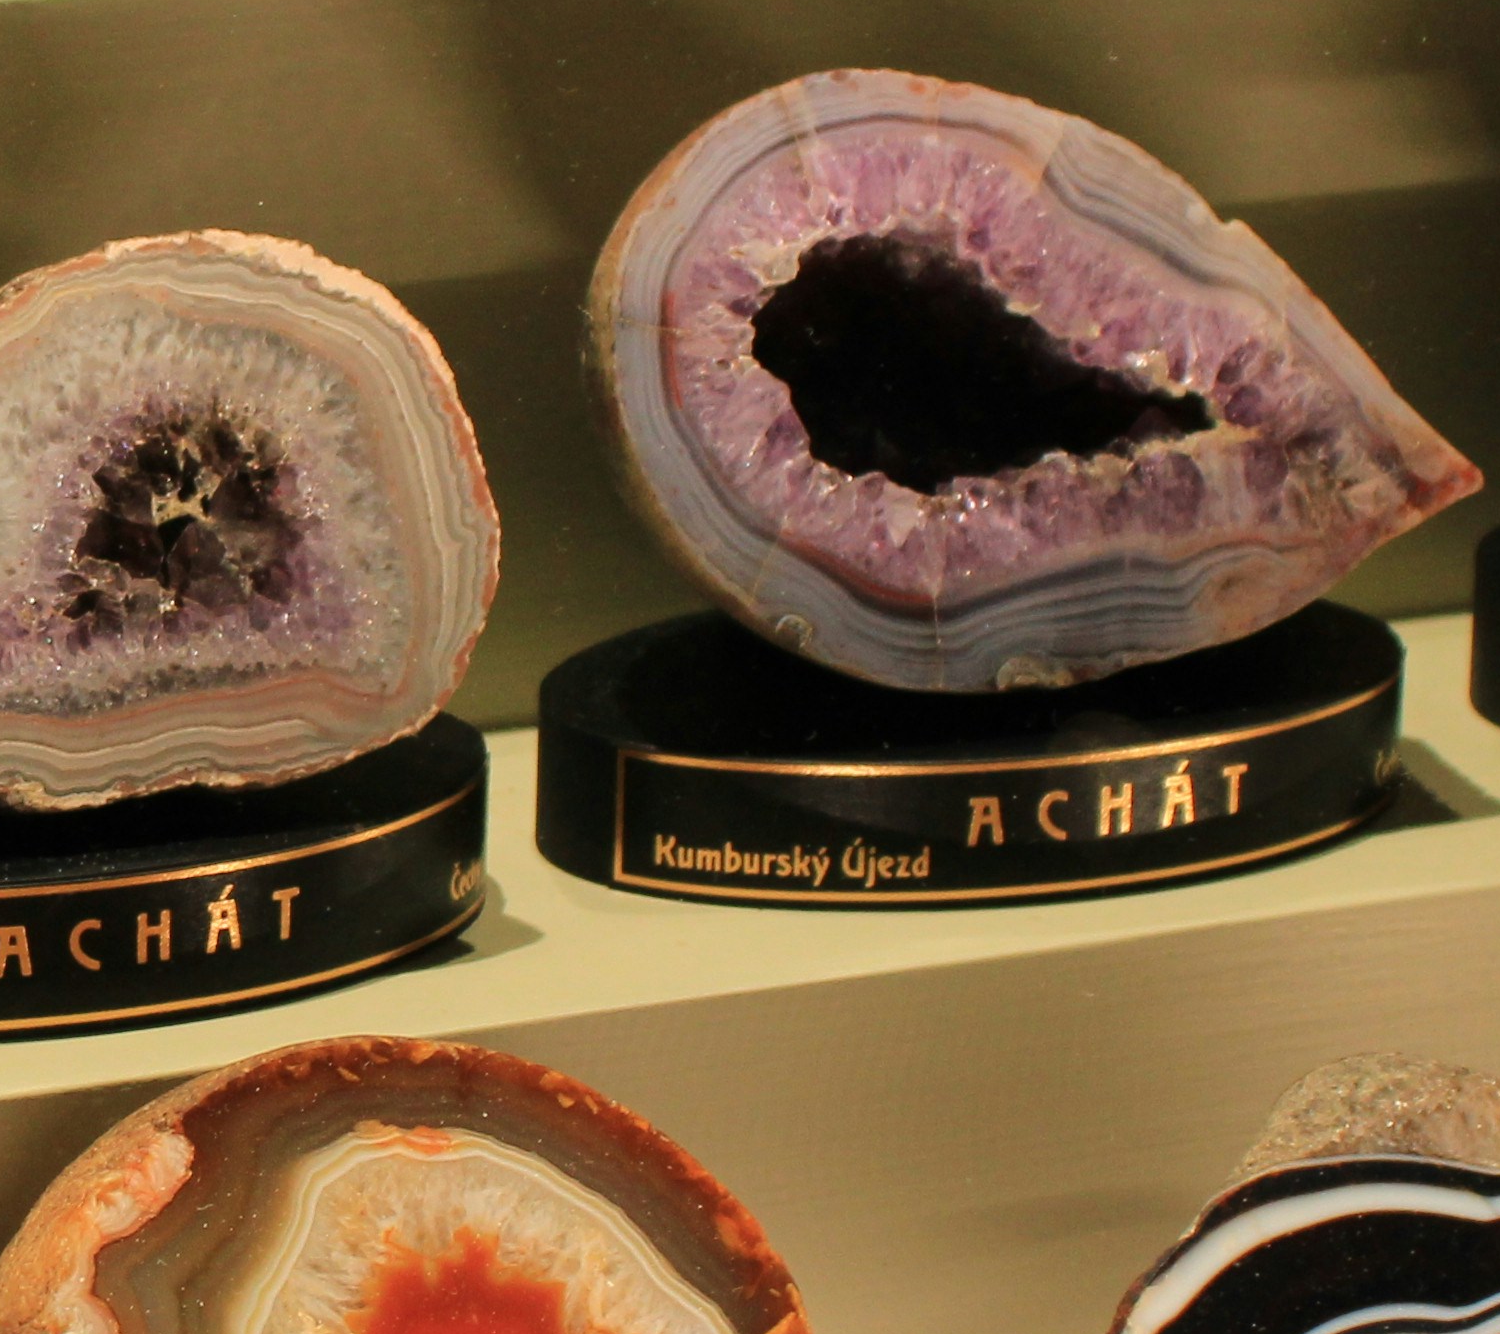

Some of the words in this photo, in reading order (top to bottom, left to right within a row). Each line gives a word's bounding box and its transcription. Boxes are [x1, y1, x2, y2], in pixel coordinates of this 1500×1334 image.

[968, 763, 1248, 845] ACHÁT
[655, 835, 830, 885] Kumburský
[841, 838, 930, 887] Újezd
